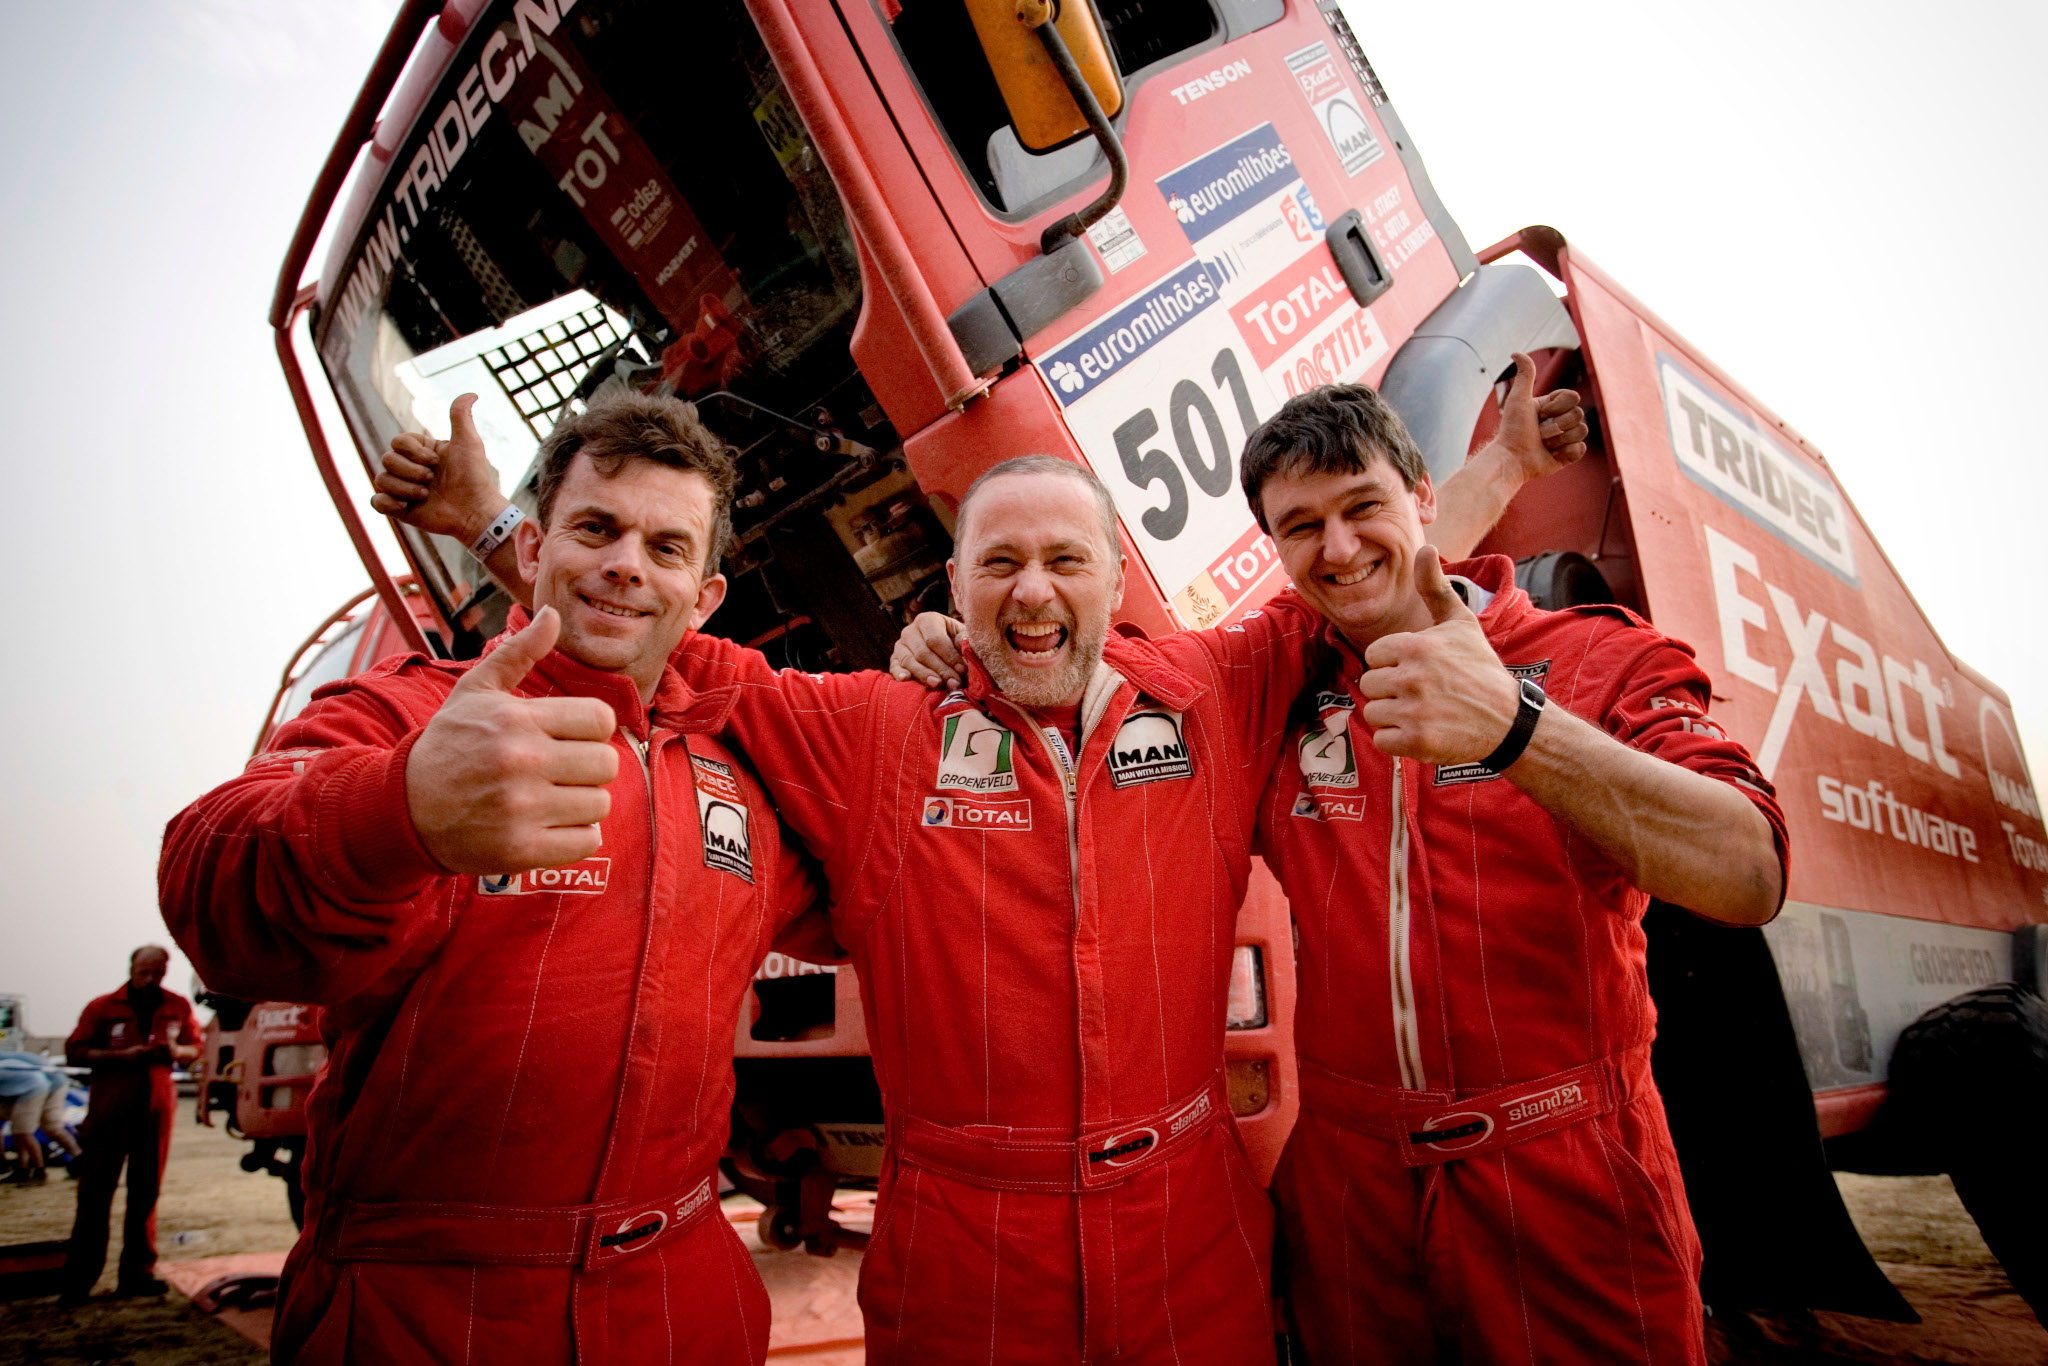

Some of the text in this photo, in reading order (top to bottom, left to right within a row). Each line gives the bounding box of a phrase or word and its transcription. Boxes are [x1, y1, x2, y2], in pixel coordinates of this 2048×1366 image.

[1171, 59, 1253, 107] TENSON
[1300, 62, 1337, 101] Exact
[1339, 127, 1373, 157] MAN
[1189, 141, 1293, 219] euromilhões
[1080, 267, 1215, 381] euromilhões
[1245, 265, 1347, 345] TOTAL
[1282, 306, 1373, 396] LOCTITE
[1113, 347, 1262, 541] 501
[1677, 388, 1843, 555] TRIDEC
[1212, 533, 1278, 590] TOT
[1704, 525, 1962, 783] Exact
[1117, 743, 1180, 768] MAN
[1118, 772, 1136, 781] MAN
[1136, 769, 1154, 779] WITH
[1160, 763, 1188, 776] MISSION
[1442, 769, 1462, 779] MAN
[1463, 767, 1485, 777] WITH
[939, 773, 1013, 789] GROENEVELD
[953, 803, 1029, 824] TOTAL
[1320, 801, 1361, 816] TAL
[1817, 773, 1980, 864] software
[709, 830, 749, 862] MAN
[2001, 820, 2048, 873] TOTA
[529, 867, 605, 887] TOTAL
[1508, 1085, 1582, 1122] stand21
[827, 1130, 885, 1148] TEN
